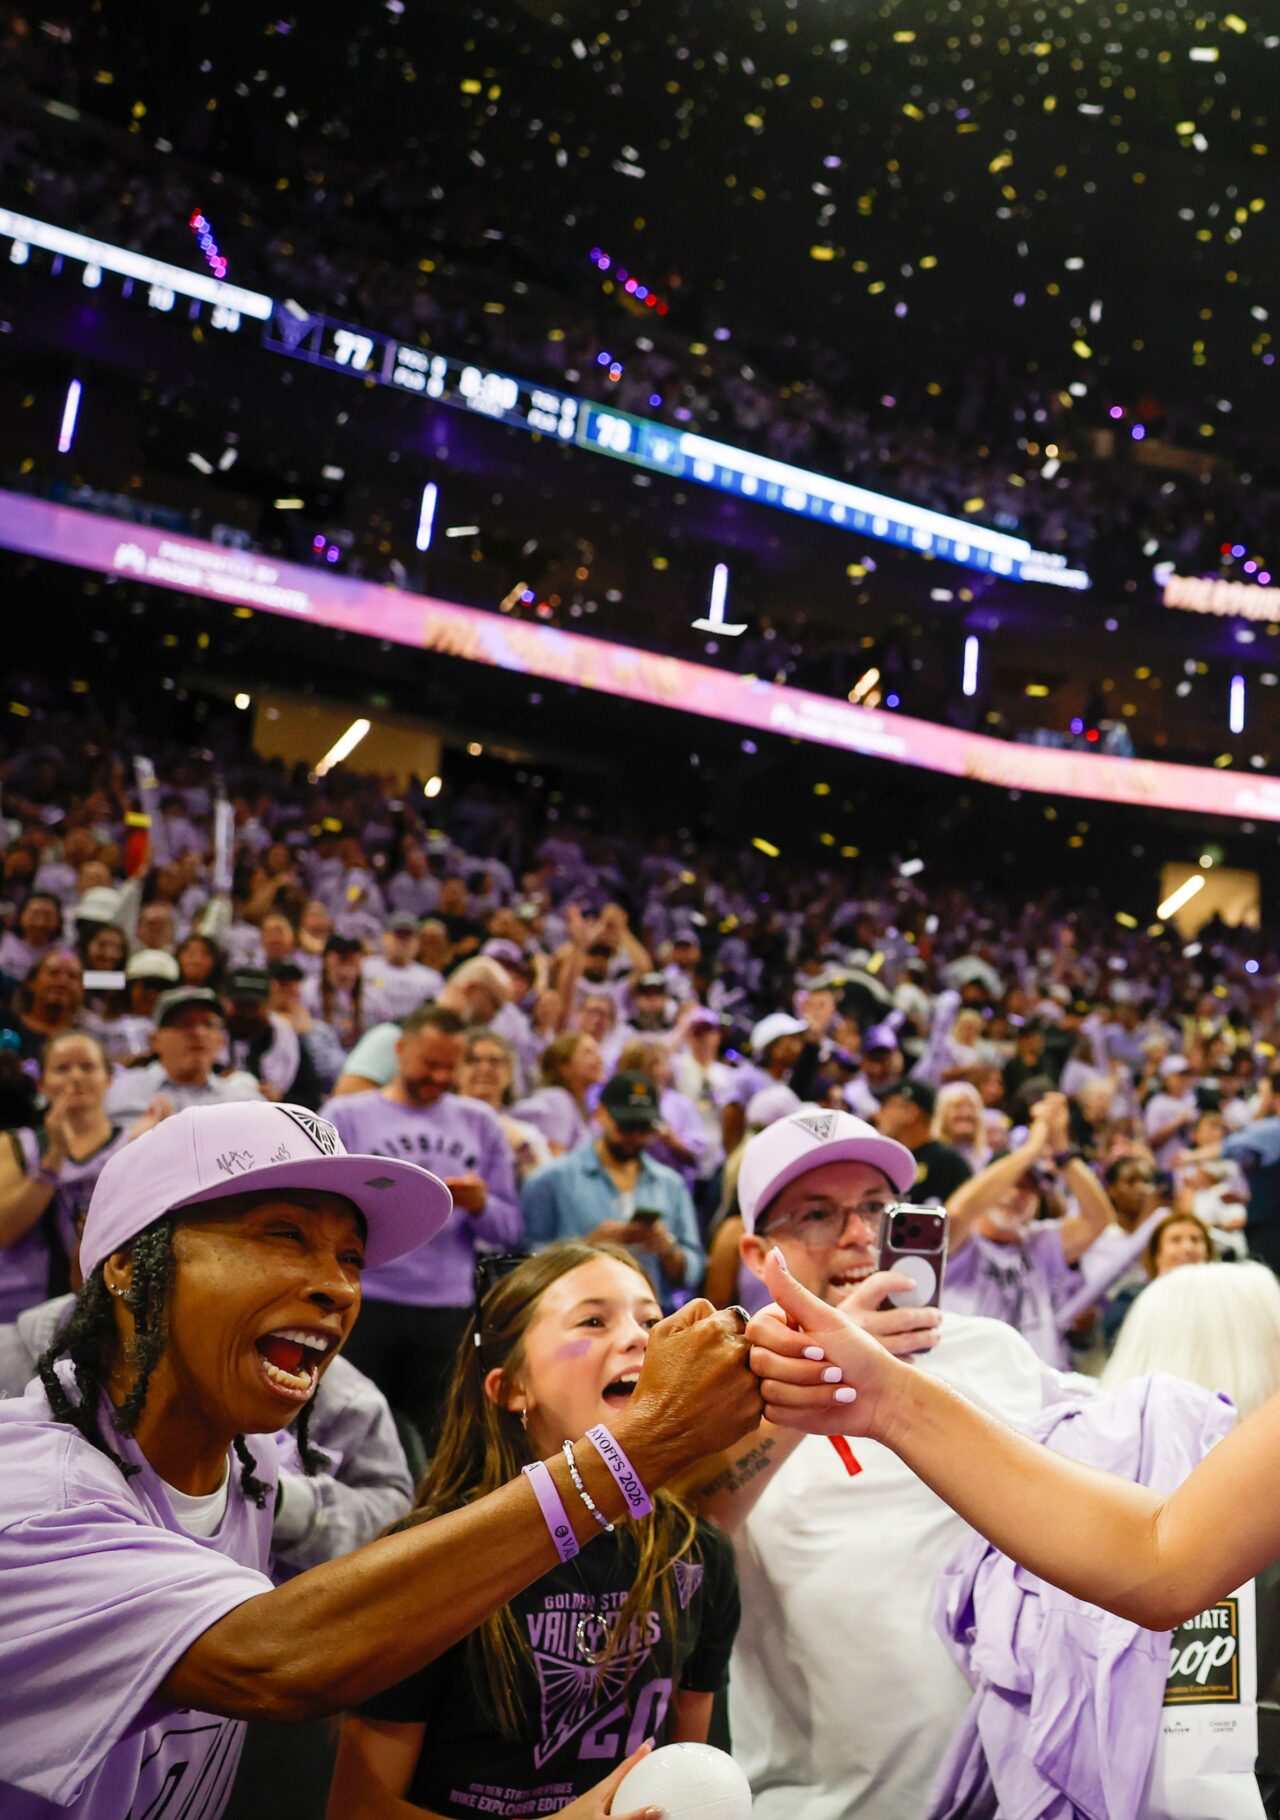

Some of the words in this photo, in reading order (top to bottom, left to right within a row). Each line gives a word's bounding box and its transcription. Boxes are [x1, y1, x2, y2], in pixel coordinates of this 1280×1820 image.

[333, 329, 374, 371] 77
[590, 1428, 626, 1472] AYOFFS
[619, 1471, 646, 1507] 2026
[600, 1591, 630, 1611] STA
